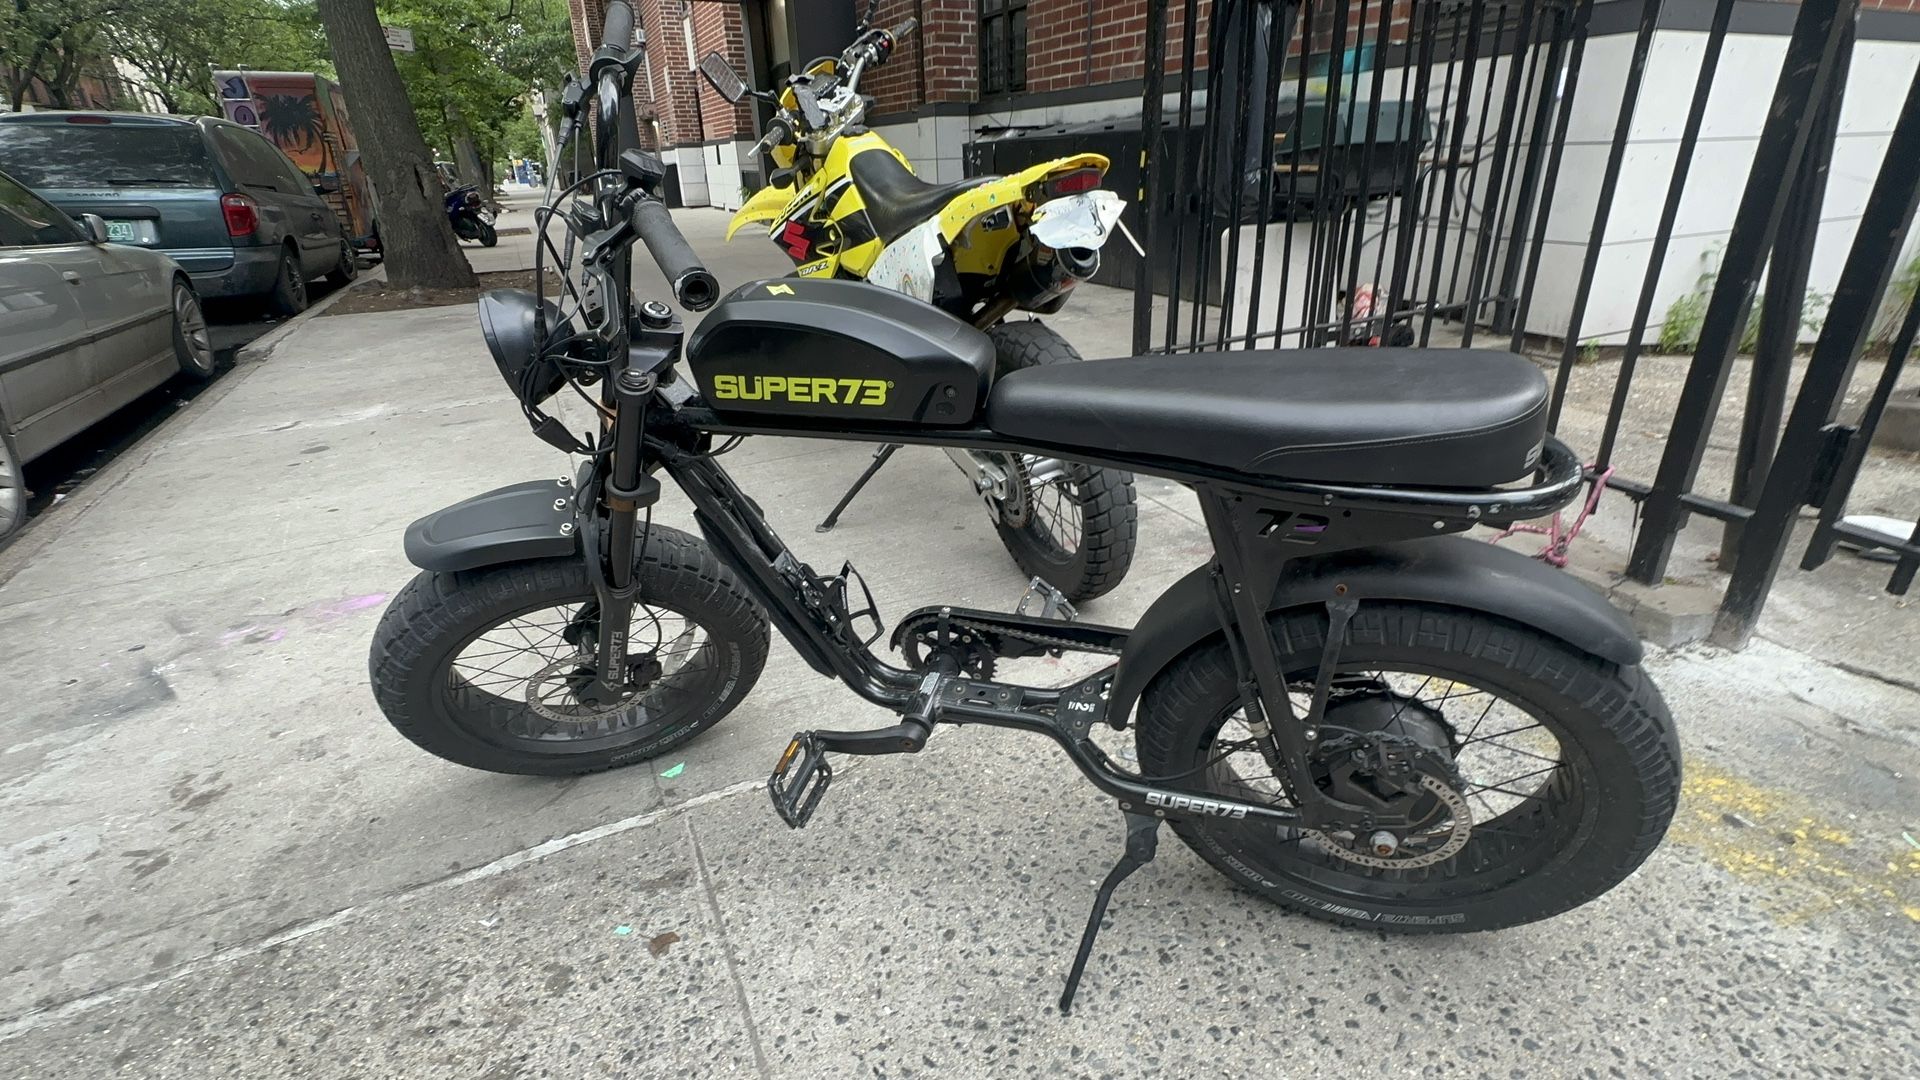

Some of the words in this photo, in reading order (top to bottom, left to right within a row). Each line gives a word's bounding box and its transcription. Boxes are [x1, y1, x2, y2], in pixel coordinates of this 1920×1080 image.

[714, 375, 888, 406] SUPER73
[608, 631, 624, 680] SUPER73
[1144, 791, 1250, 820] SUPER73
